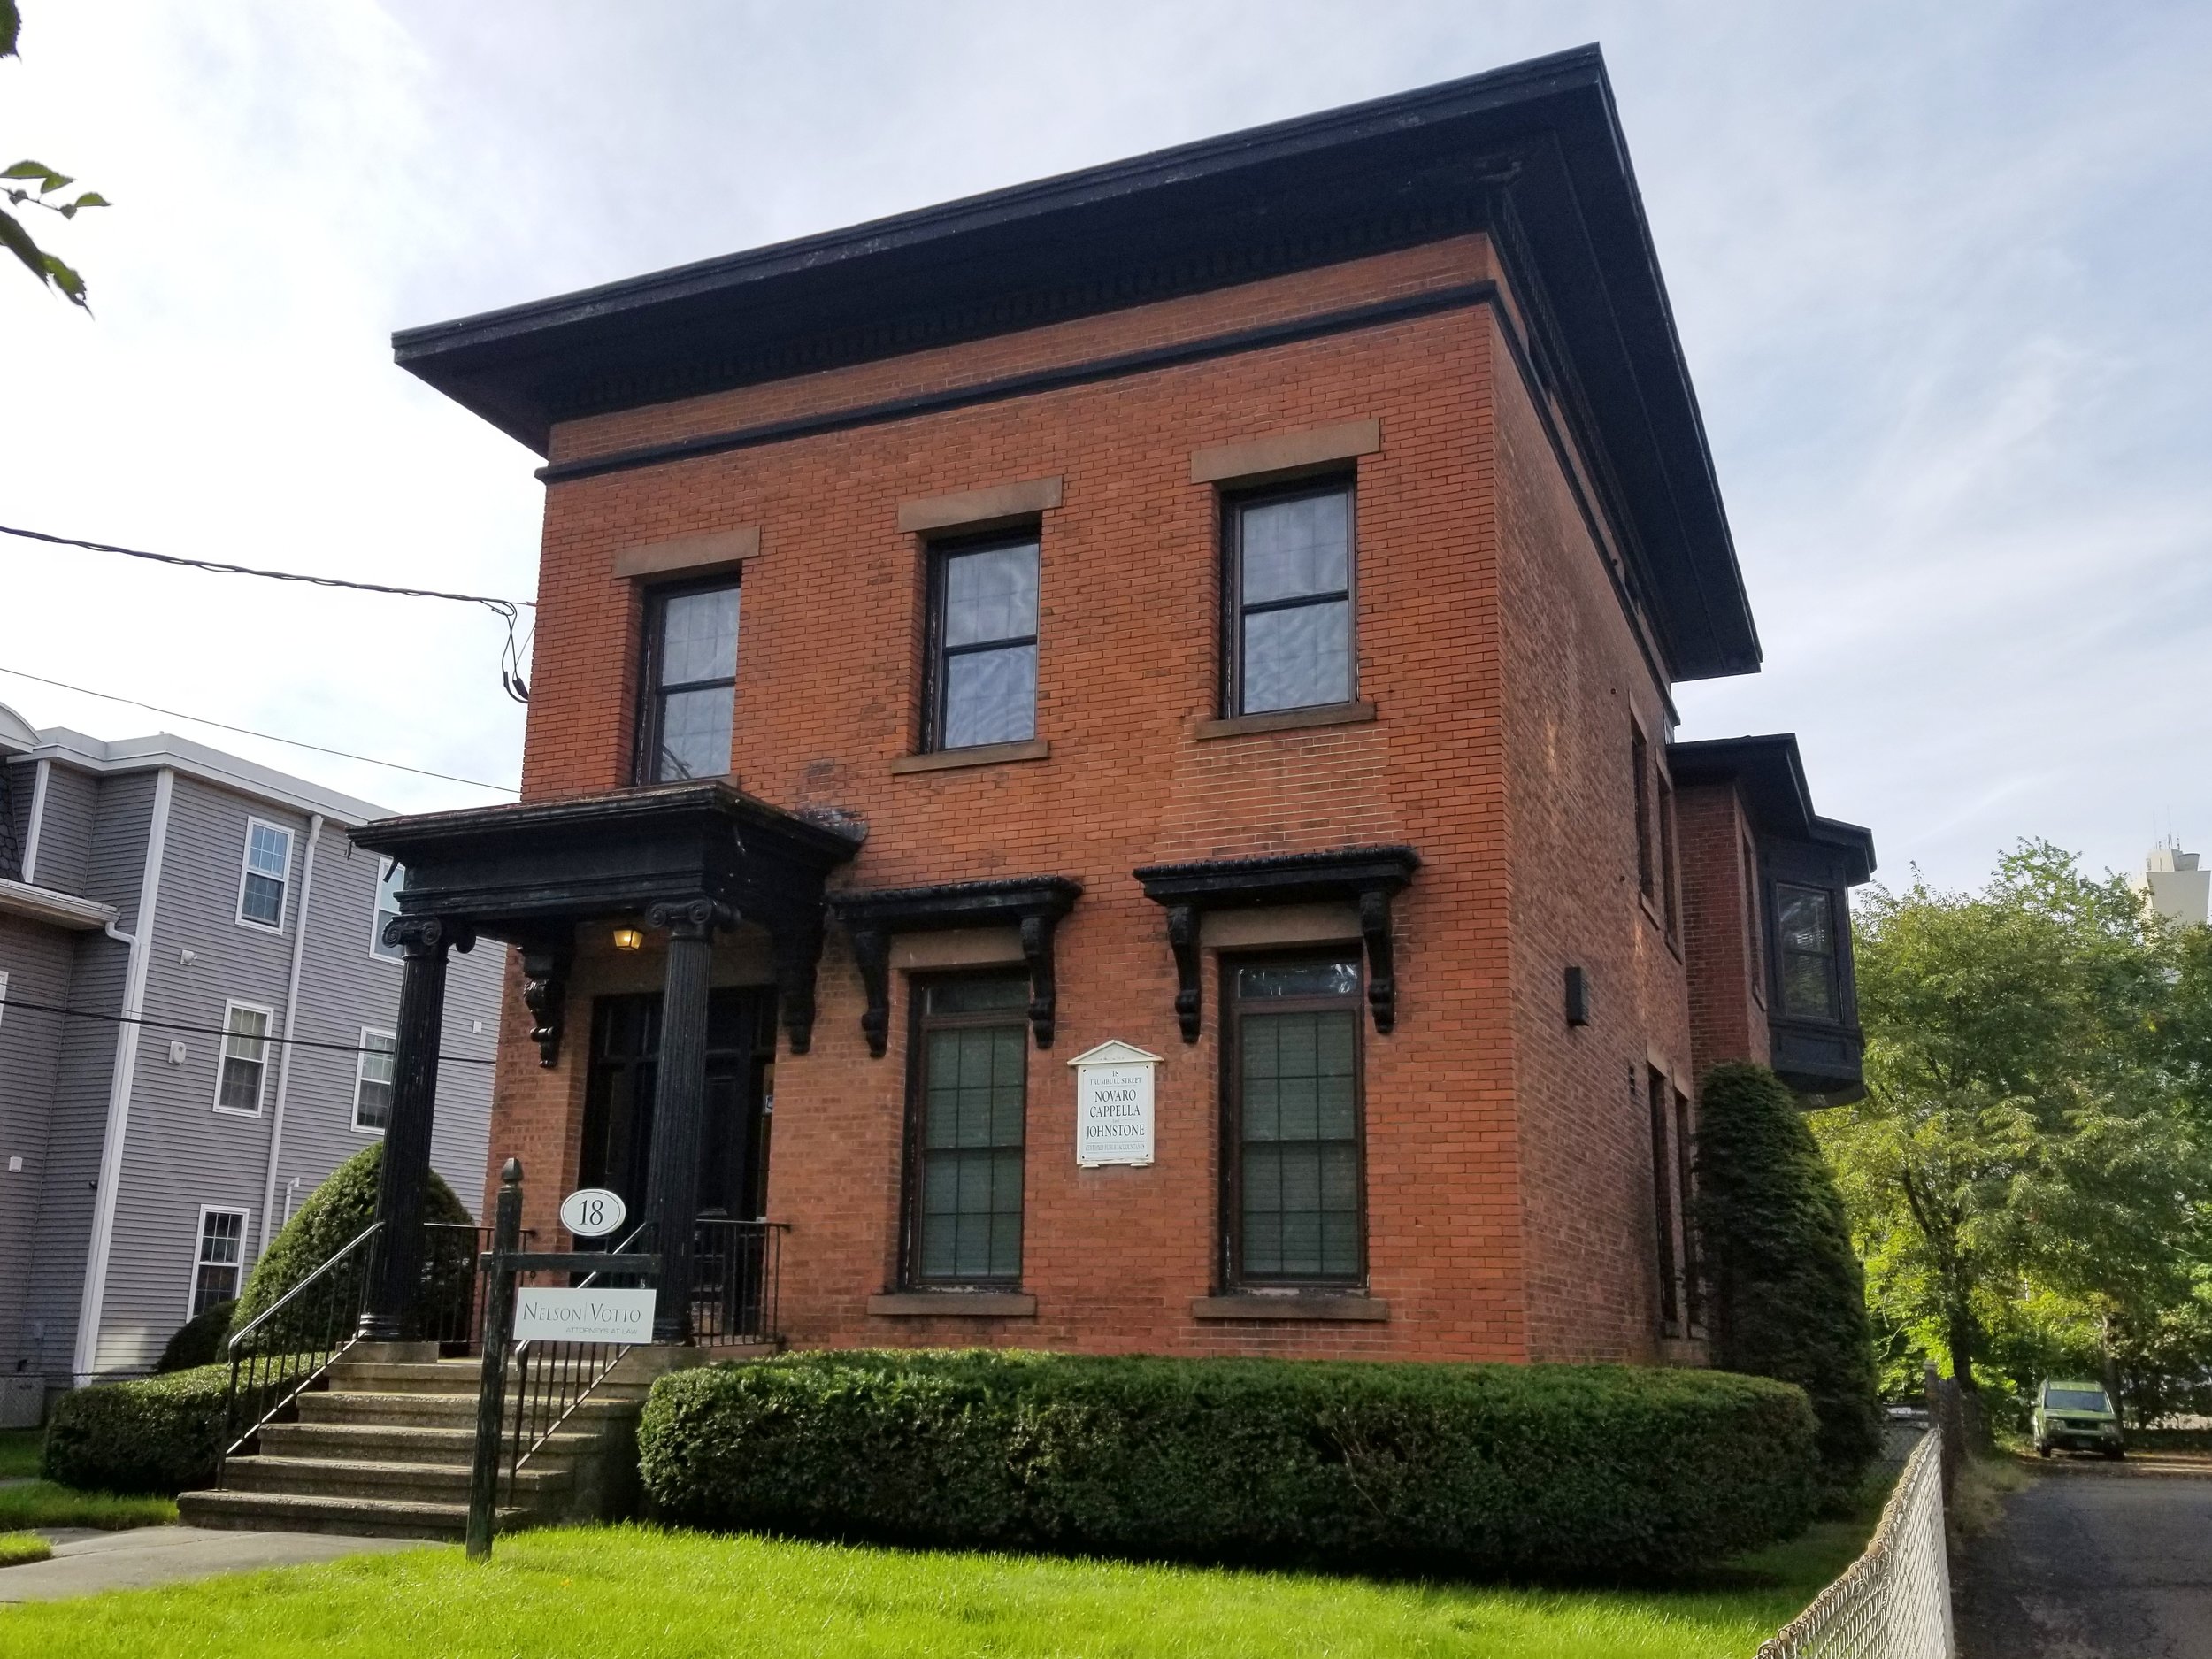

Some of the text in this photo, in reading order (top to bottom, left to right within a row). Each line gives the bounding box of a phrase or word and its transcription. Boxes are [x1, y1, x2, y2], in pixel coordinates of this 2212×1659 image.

[1094, 1089, 1137, 1102] NOVARO
[1089, 1105, 1141, 1118] CAPPELLA
[1086, 1124, 1145, 1140] JOHNSTONE
[579, 1199, 603, 1225] 18
[523, 1302, 641, 1323] NELSON VOTTO
